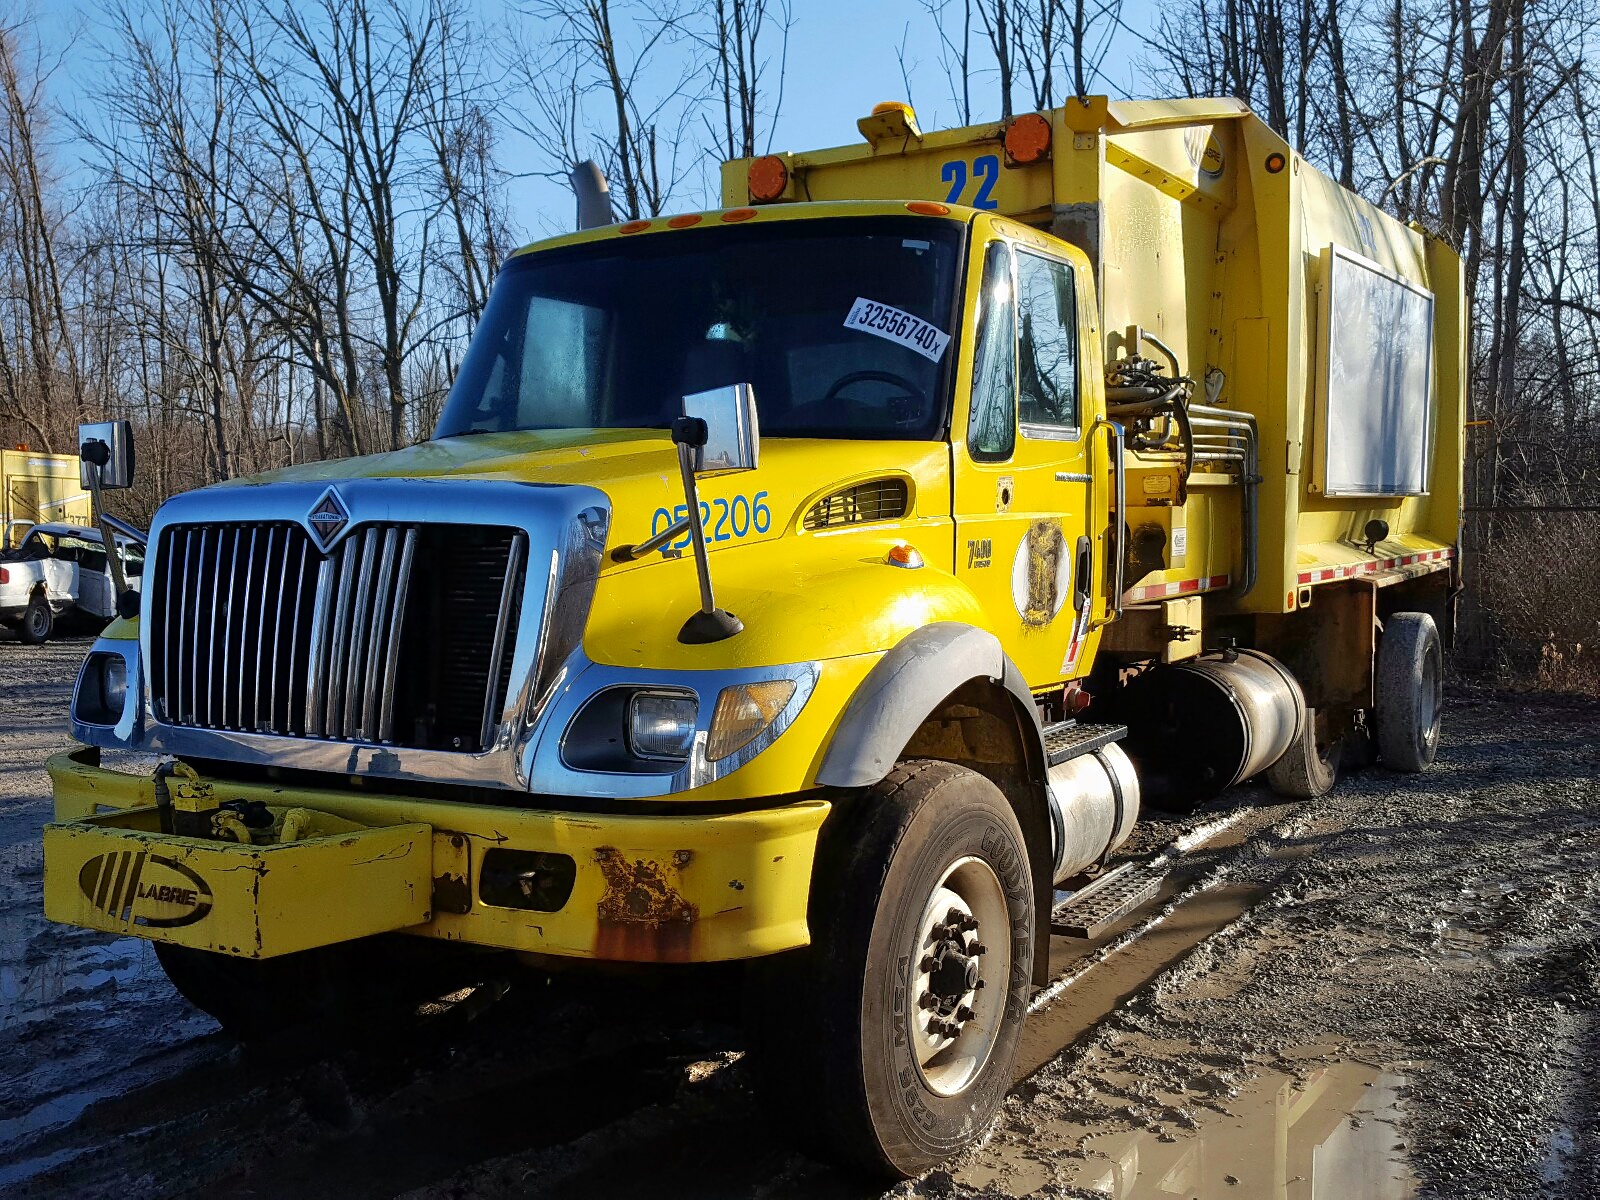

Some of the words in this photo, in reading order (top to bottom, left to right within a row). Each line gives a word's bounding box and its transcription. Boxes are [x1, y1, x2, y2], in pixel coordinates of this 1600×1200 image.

[941, 154, 999, 210] 22
[651, 490, 771, 553] 052206
[137, 882, 198, 906] LABRIE
[981, 825, 1029, 1026] GOODYEAR
